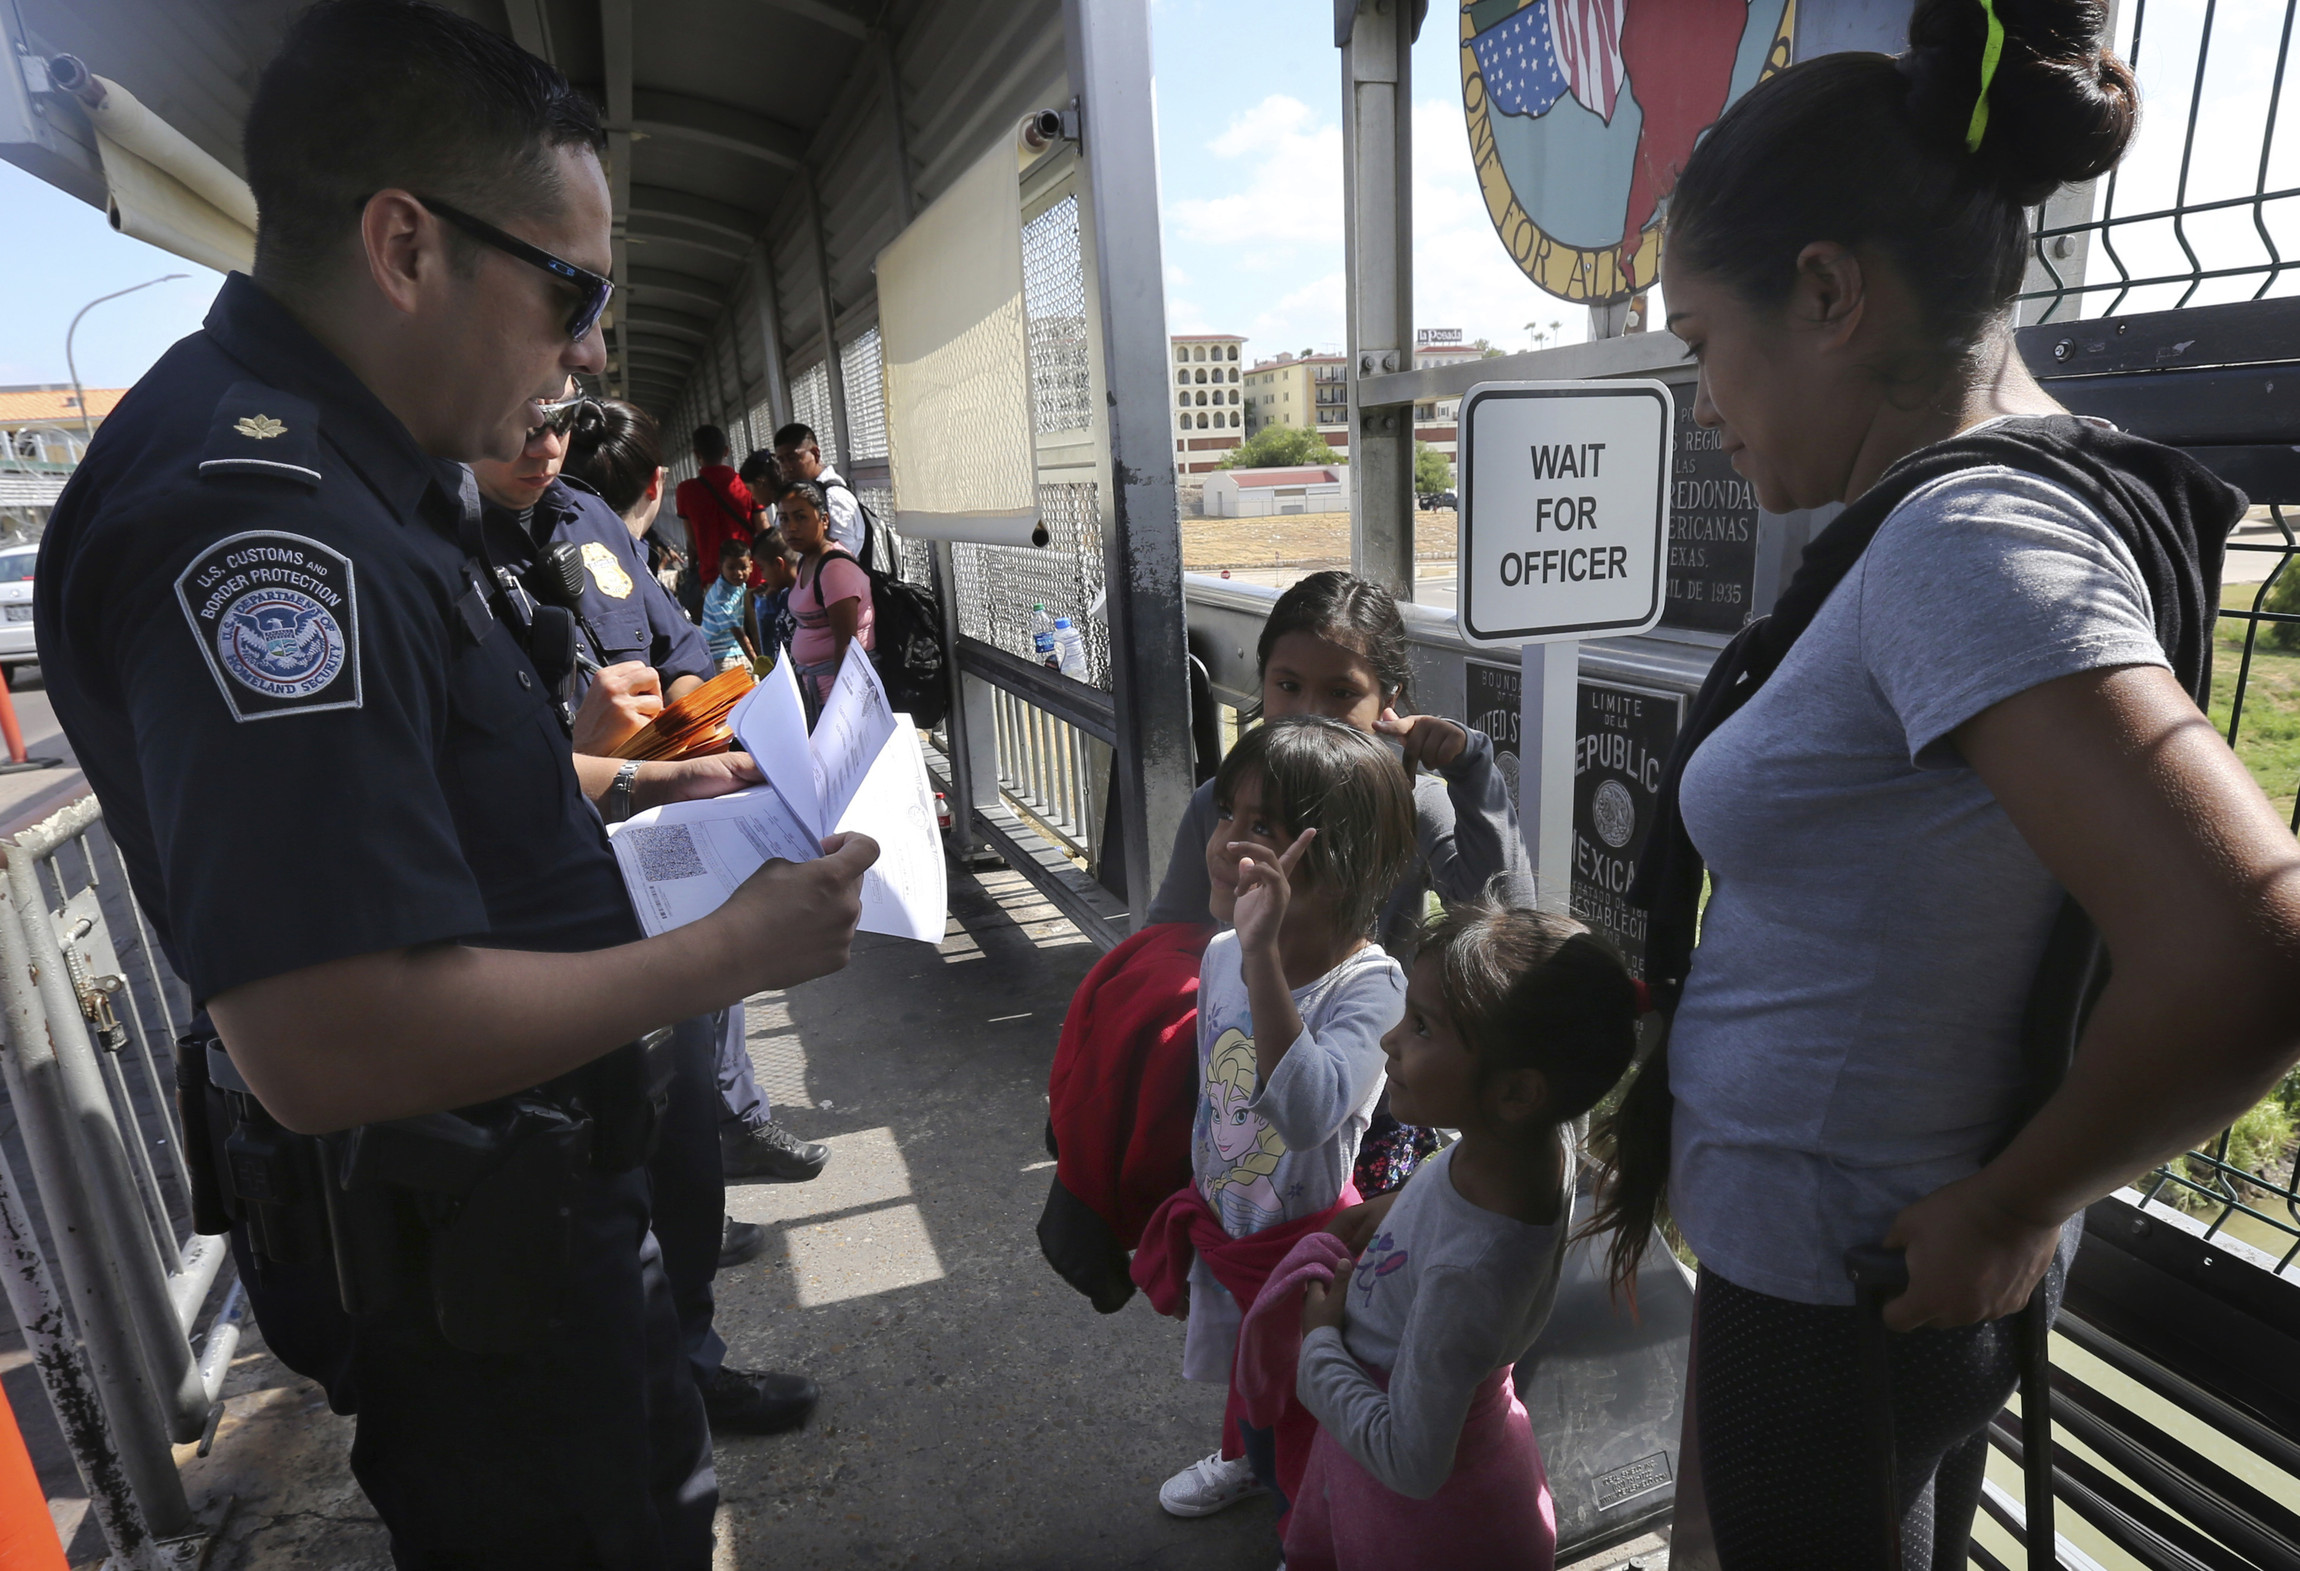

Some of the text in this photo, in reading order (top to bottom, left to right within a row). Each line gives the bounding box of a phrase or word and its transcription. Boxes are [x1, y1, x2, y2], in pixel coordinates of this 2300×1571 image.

[1465, 71, 1500, 190] ONE
[1498, 197, 1552, 287] FOR
[1530, 443, 1606, 480] WAIT
[1675, 459, 1696, 474] LAS
[1535, 496, 1598, 533] FOR
[197, 547, 328, 588] U.S. CUSTOMS AND
[1500, 546, 1628, 587] OFFICER
[1669, 547, 1709, 568] EXAS.
[201, 568, 341, 620] BORDER PROTECTION
[1687, 581, 1703, 600] DE
[1711, 582, 1742, 604] 1935
[236, 591, 322, 619] DEPARTMENT
[320, 615, 335, 633] OF
[226, 644, 341, 694] HOMELAND SECURITY
[1592, 692, 1642, 717] LIMITE
[1604, 714, 1628, 729] DE LA
